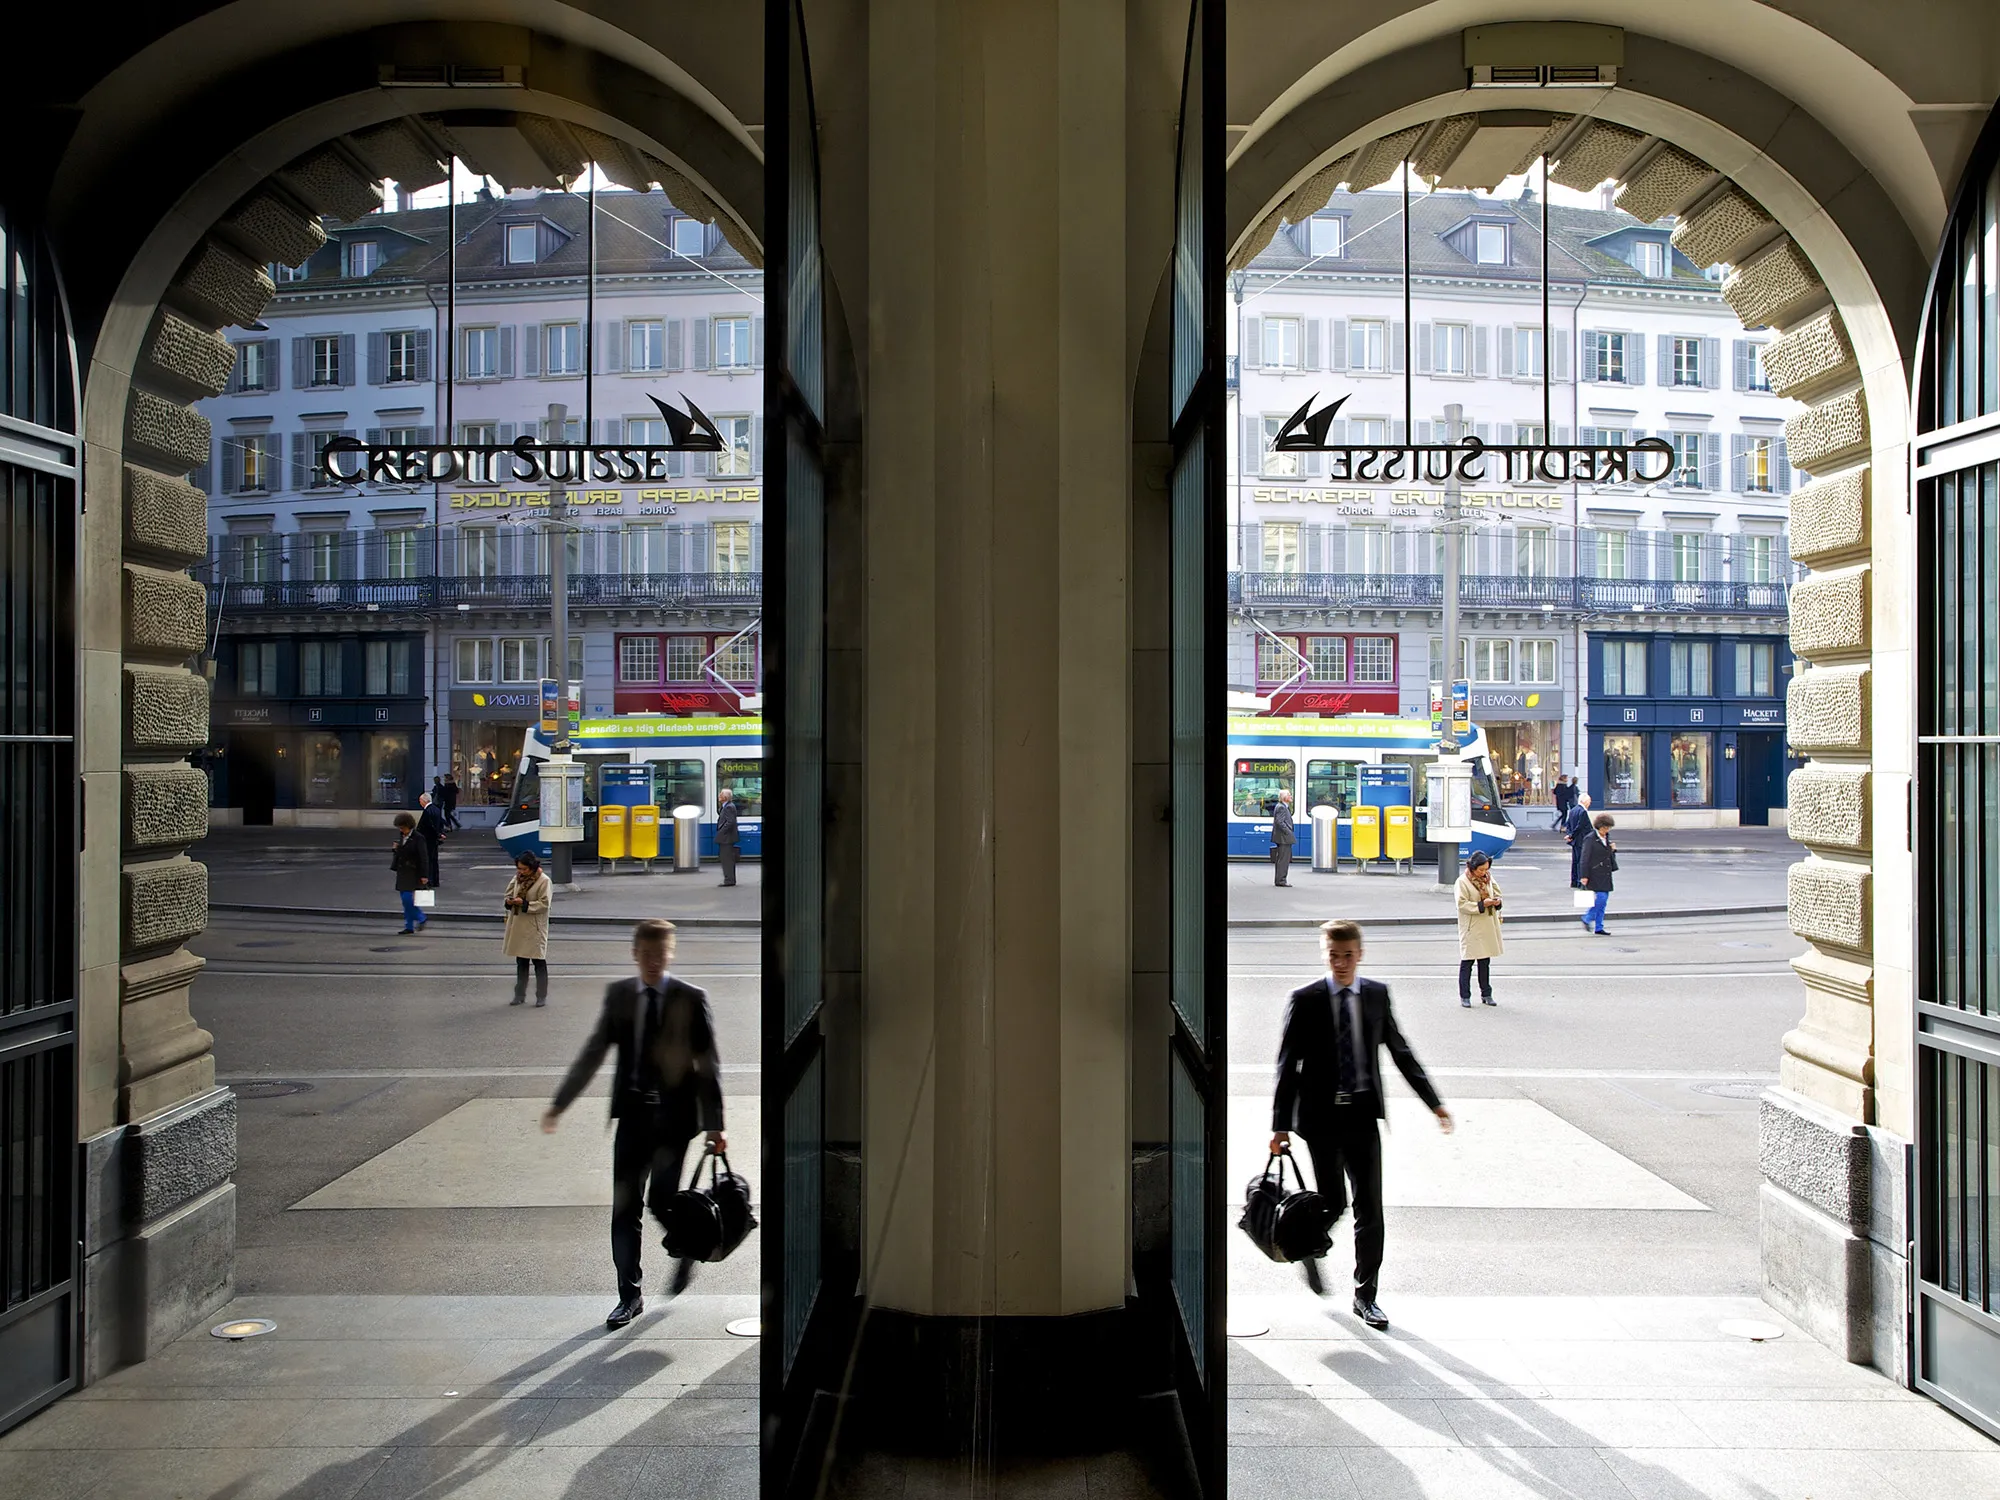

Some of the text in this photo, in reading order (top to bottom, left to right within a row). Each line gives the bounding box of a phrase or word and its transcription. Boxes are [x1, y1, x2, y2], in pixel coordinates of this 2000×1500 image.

[322, 435, 671, 483] CREDIT SUISSE
[1253, 487, 1565, 509] SCHAEPPI GRUDSTÜCKE
[1337, 505, 1375, 516] ZÜRICH
[1390, 507, 1421, 516] BASEL
[1482, 694, 1524, 707] LEMON
[1743, 708, 1779, 718] HACKETT
[1253, 762, 1289, 773] Farbhof
